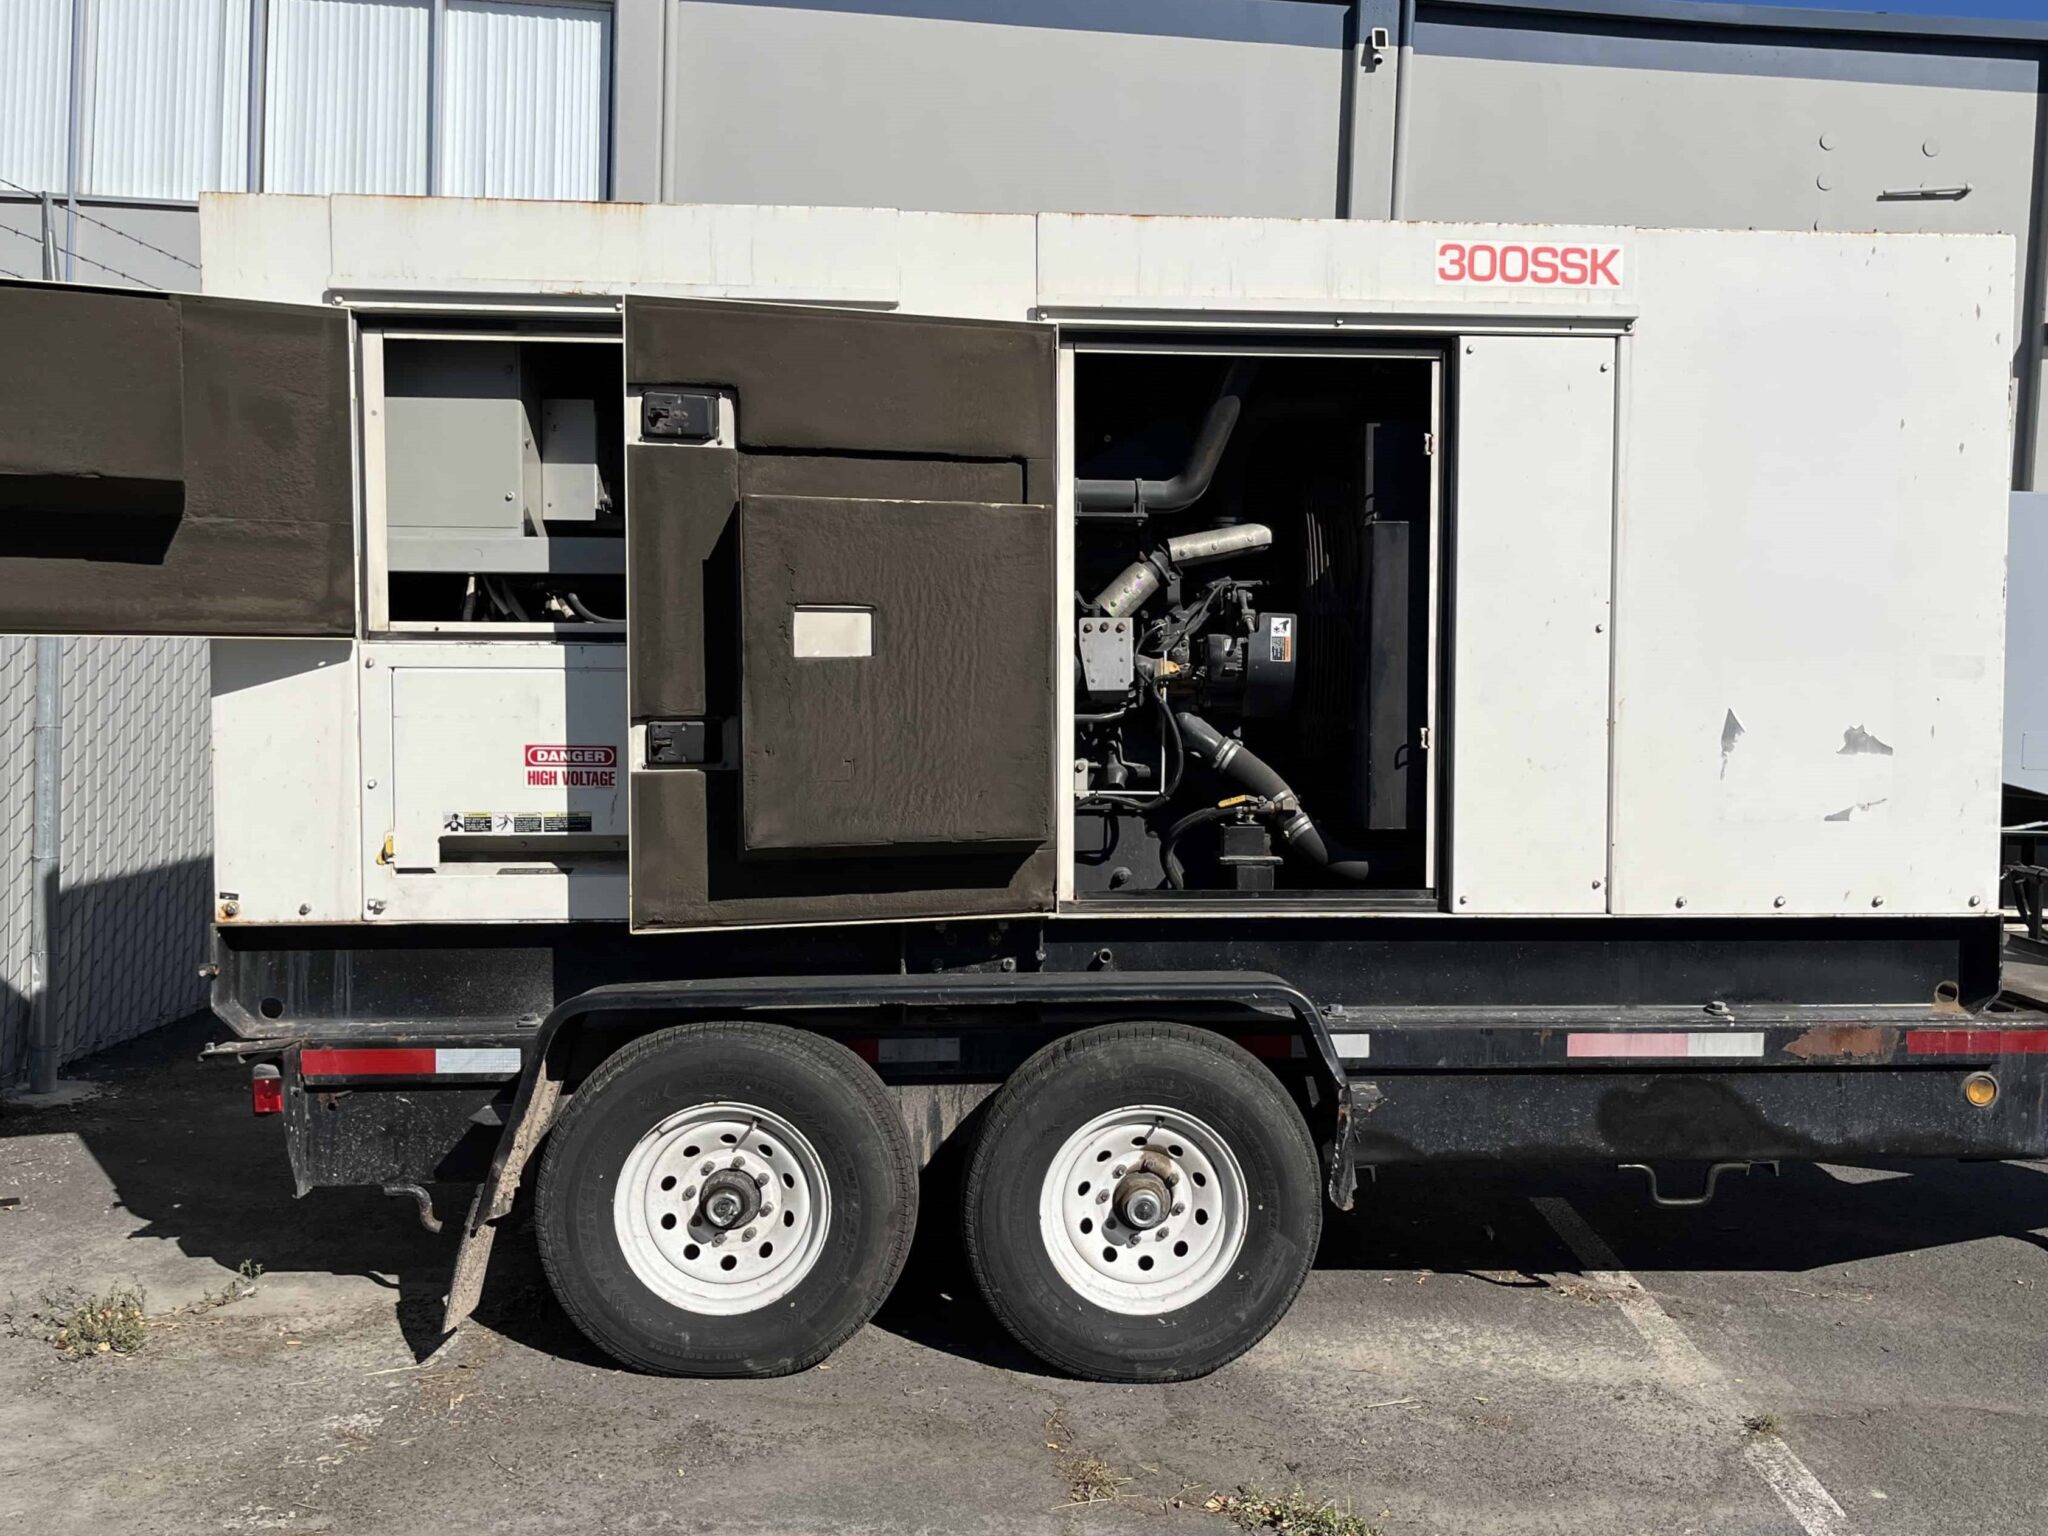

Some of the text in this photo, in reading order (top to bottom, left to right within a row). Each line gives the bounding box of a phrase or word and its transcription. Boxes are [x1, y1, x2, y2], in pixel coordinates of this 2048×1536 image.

[1438, 243, 1620, 286] 300SSK
[536, 750, 605, 762] DANGER
[527, 770, 616, 786] HIGH VOLTAGE
